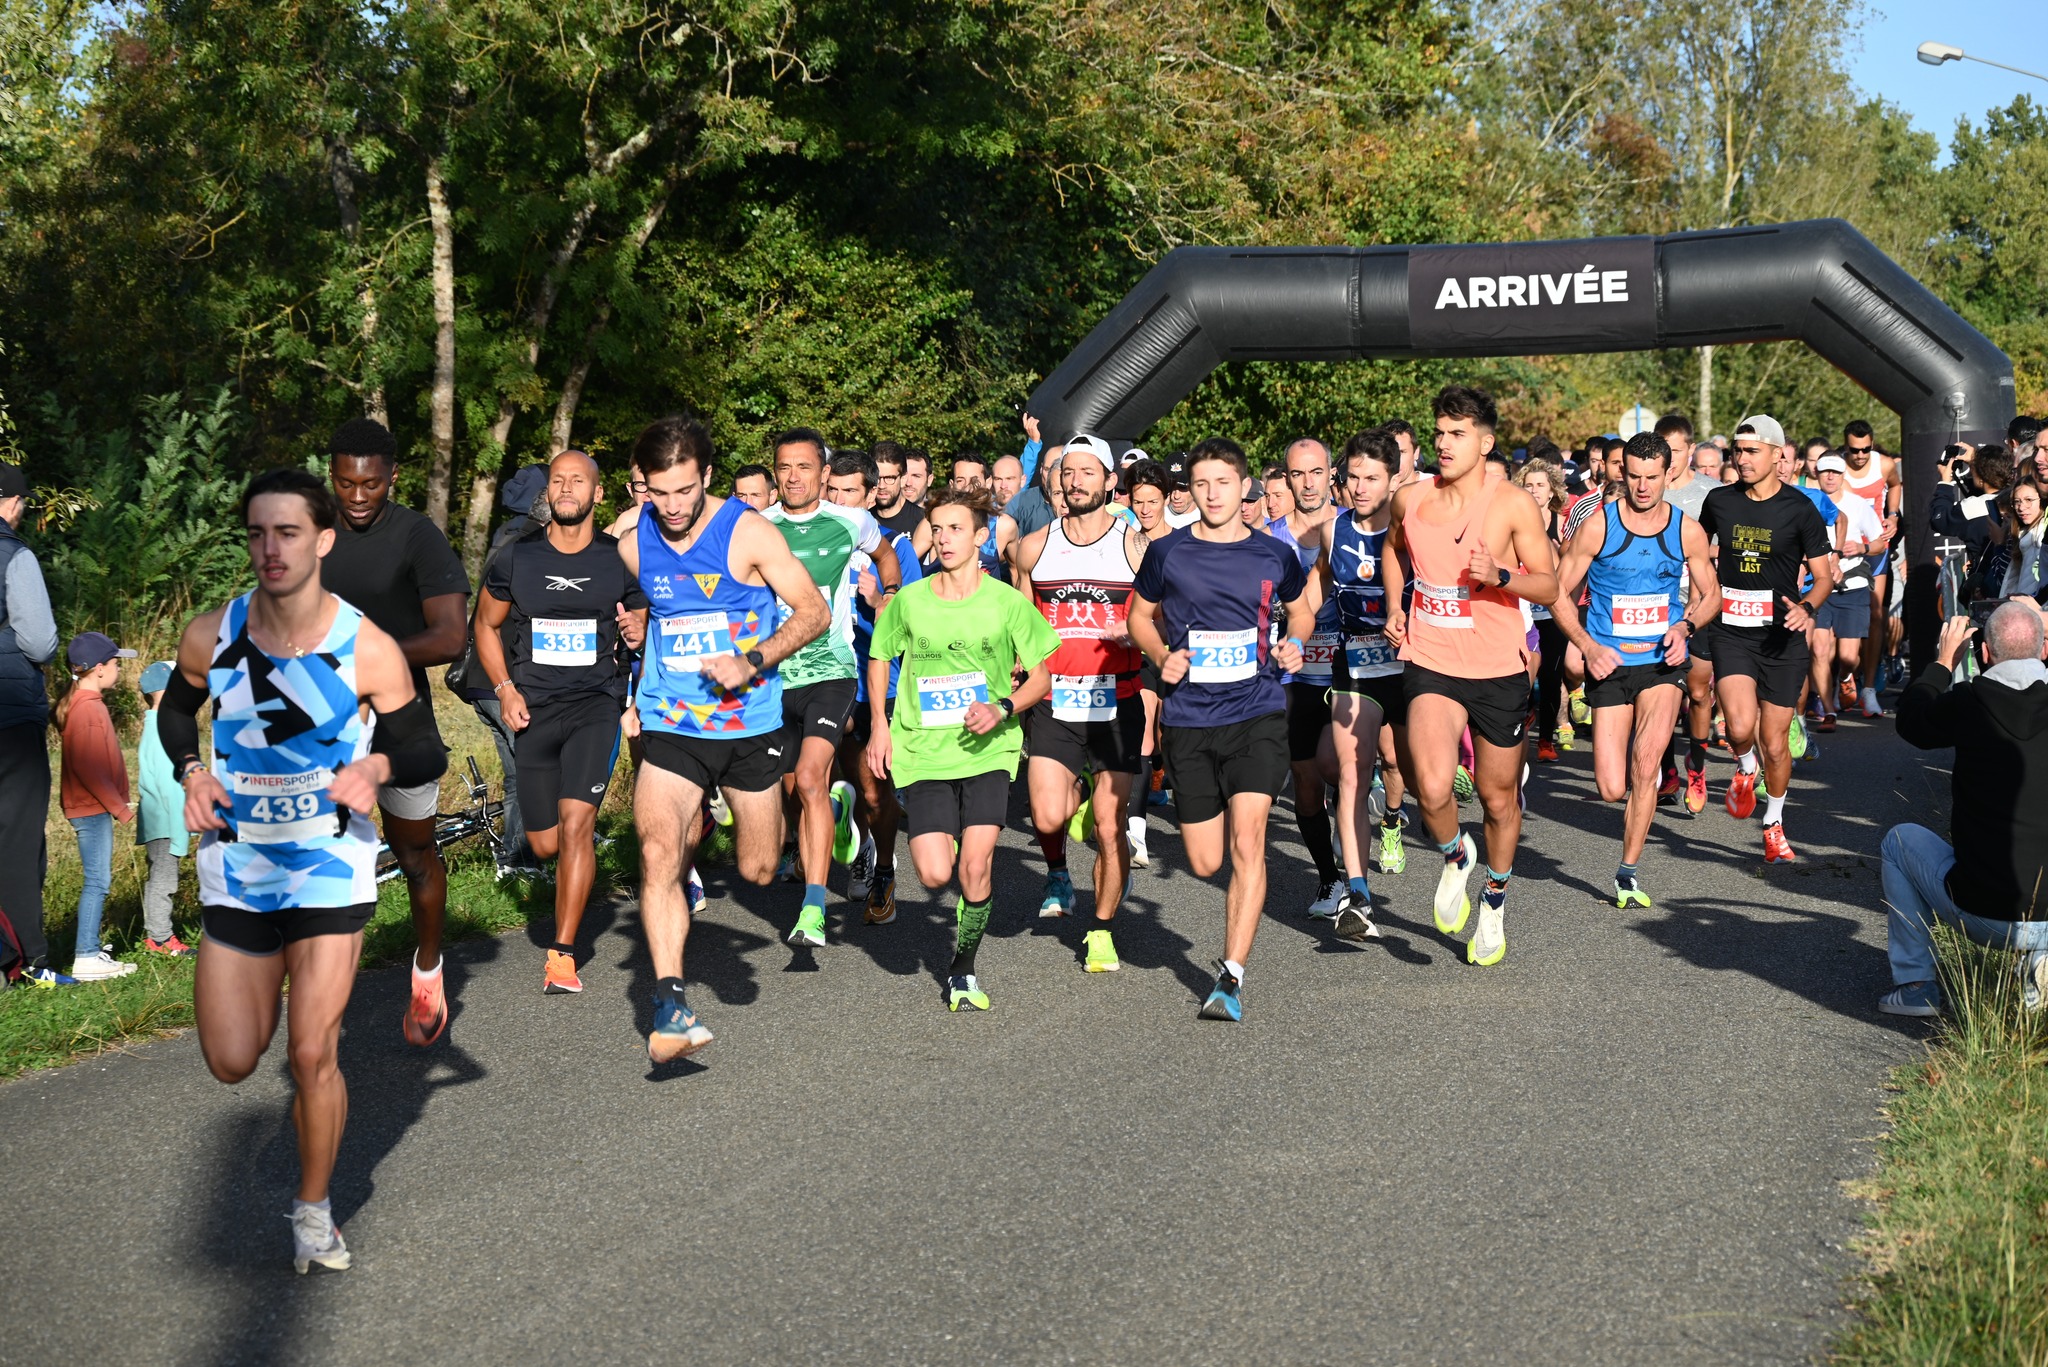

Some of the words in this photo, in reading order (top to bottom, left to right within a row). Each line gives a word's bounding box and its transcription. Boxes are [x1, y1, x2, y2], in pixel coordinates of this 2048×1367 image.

[1435, 264, 1628, 309] ARRIVÉE
[1740, 562, 1761, 573] LAST
[1048, 598, 1060, 627] CLUB
[1422, 595, 1460, 617] 536
[1729, 601, 1764, 616] 466
[544, 620, 589, 628] INTERSPORT
[671, 615, 718, 627] INTERSPORT
[1622, 607, 1659, 624] 694
[543, 633, 586, 652] 336
[673, 631, 717, 656] 441
[1203, 631, 1251, 640] INTERSPORT
[1202, 646, 1248, 667] 269
[1356, 648, 1396, 666] 331
[929, 673, 976, 685] INTERSPORT
[930, 687, 977, 711] 339
[1063, 689, 1107, 708] 296
[250, 772, 320, 787] INTERSPORT
[250, 793, 319, 823] 439
